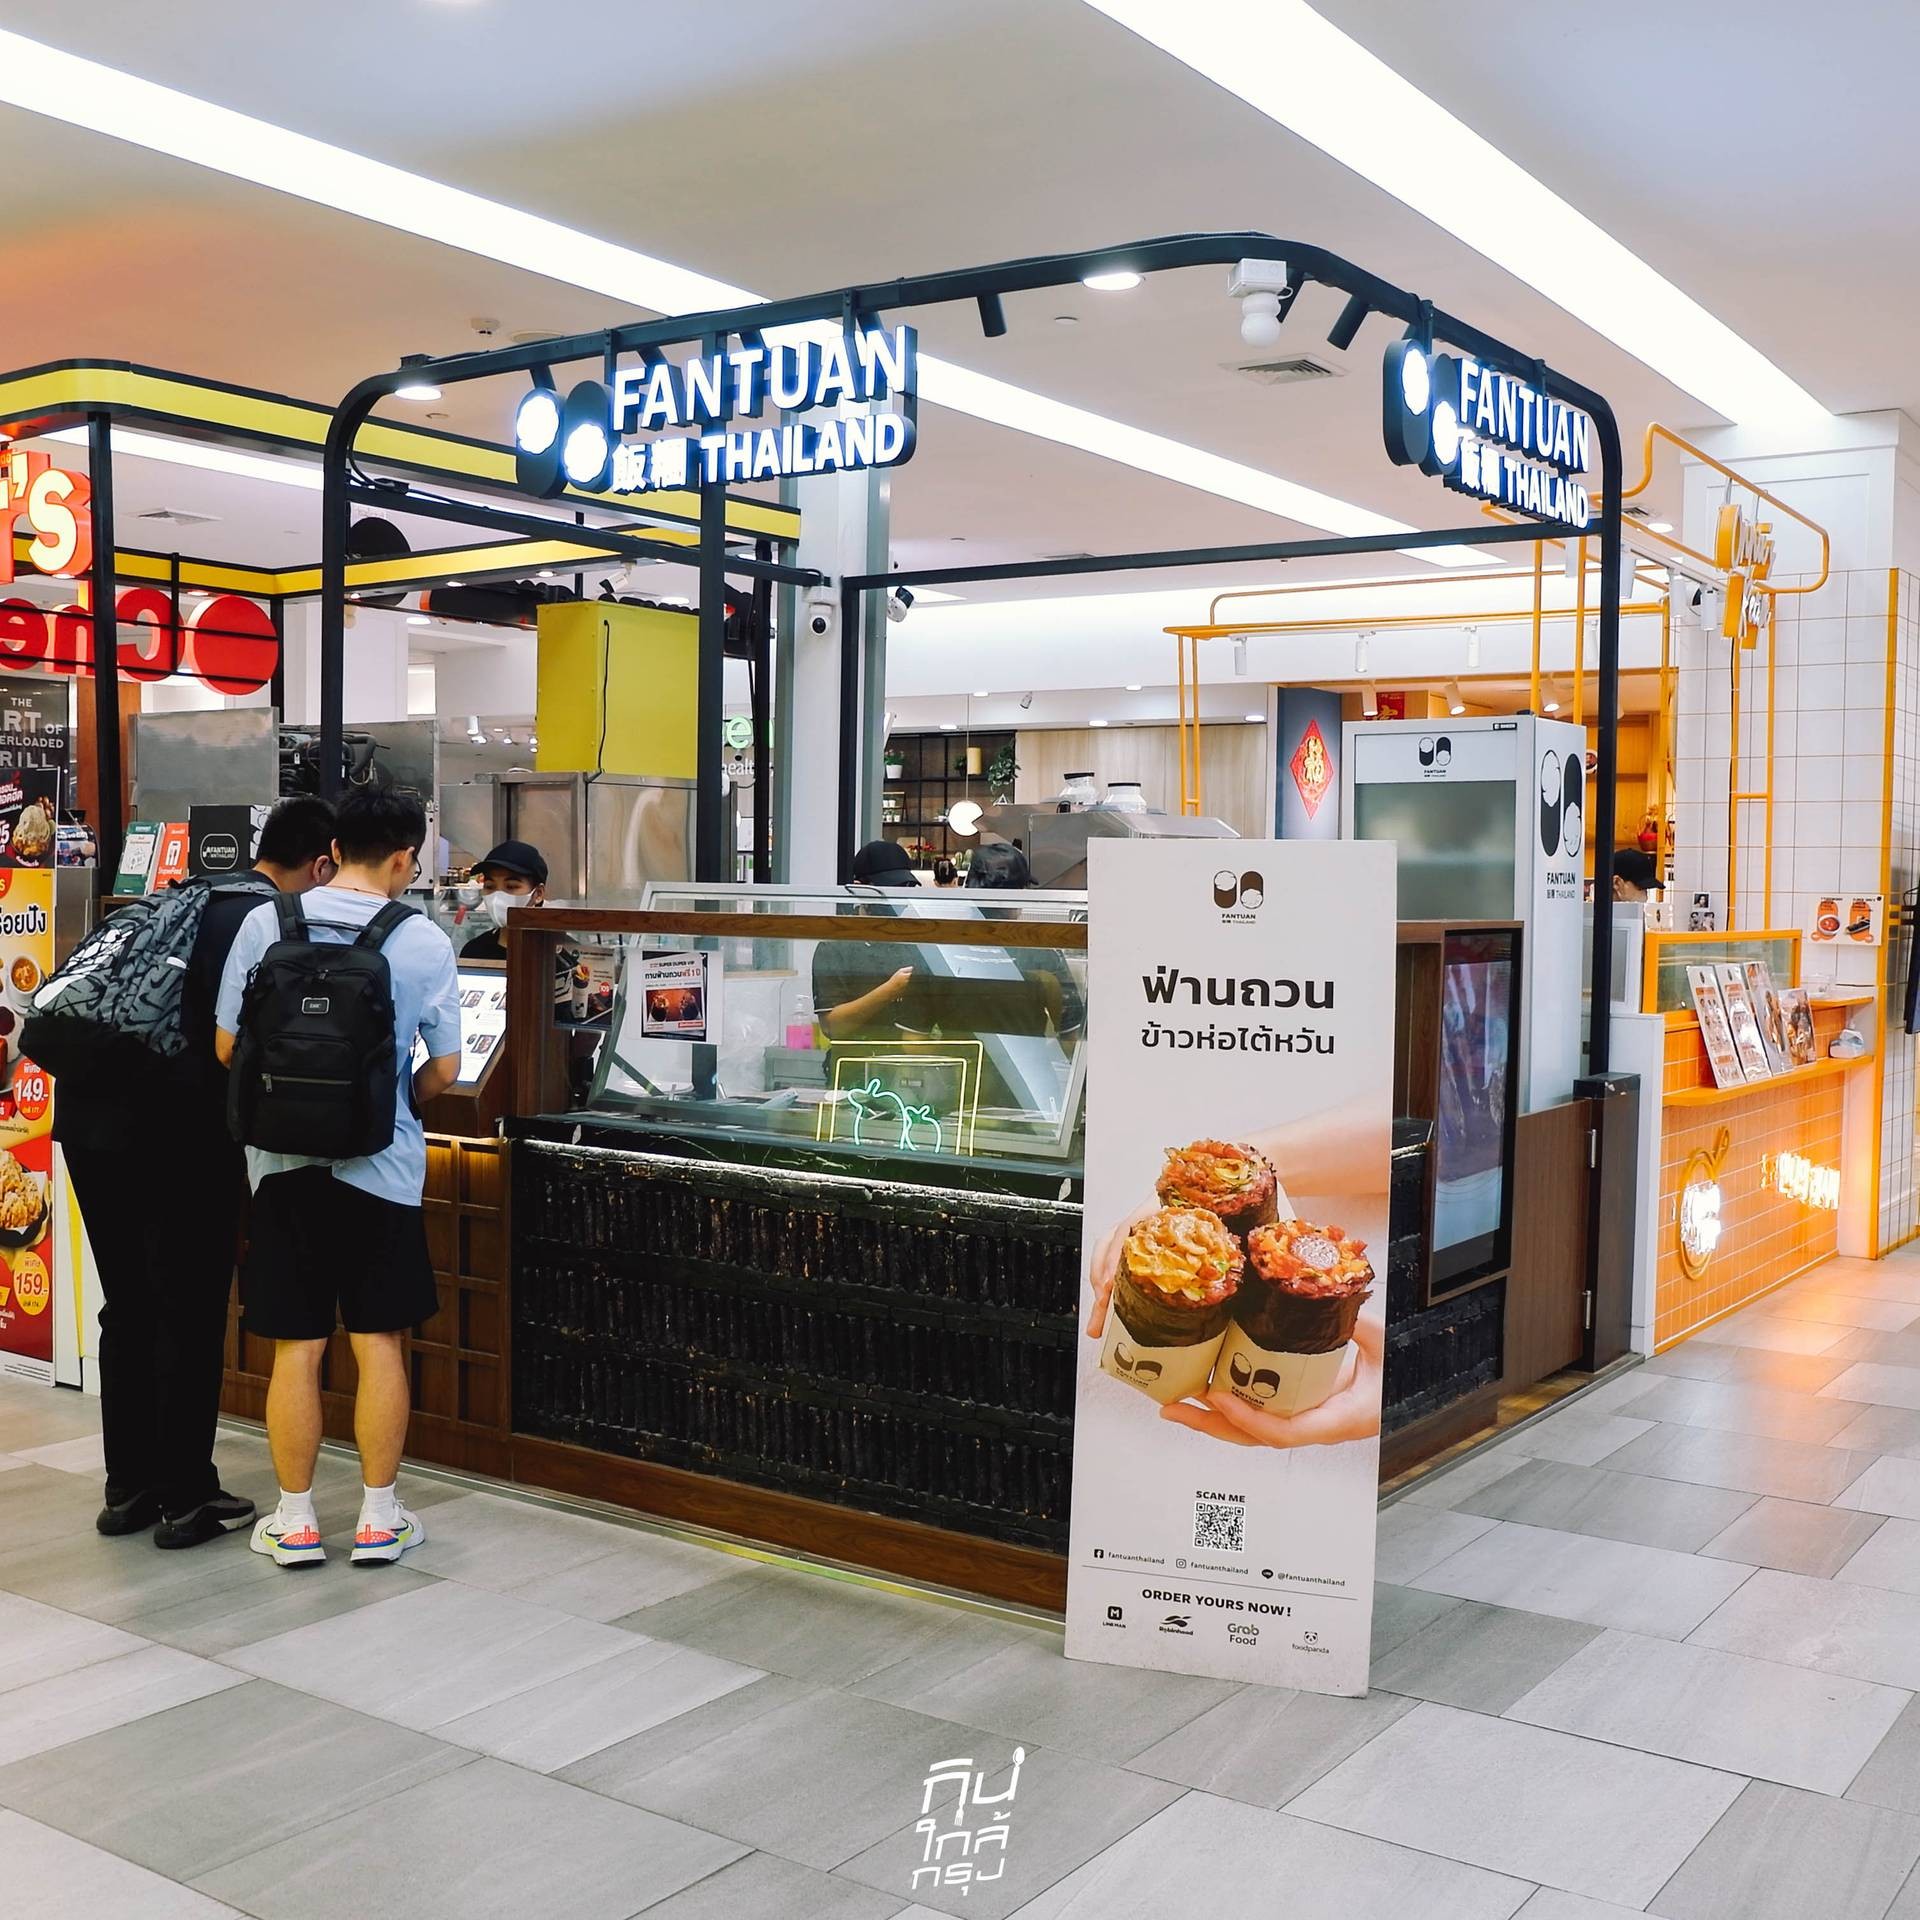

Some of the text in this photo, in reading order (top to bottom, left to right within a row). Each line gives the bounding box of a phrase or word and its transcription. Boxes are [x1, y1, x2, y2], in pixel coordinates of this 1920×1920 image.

[613, 325, 909, 432] FANTUAN
[1461, 358, 1589, 474] FANTUAN
[700, 413, 908, 485] THAILAND
[1503, 456, 1589, 530] THAILAND
[11, 697, 33, 707] THE
[0, 709, 64, 735] RT OF
[1546, 872, 1576, 885] FANTUAN
[1141, 964, 1335, 1010] ฟ่านถวน
[1141, 1020, 1336, 1055] ข้าวห่อไต้หวัน
[1196, 1490, 1246, 1503] SCAN ME
[1108, 1551, 1165, 1565] fantuanthailand
[1190, 1561, 1249, 1575] fantuanthailand
[1277, 1572, 1346, 1587] @fantuanthailand
[1142, 1588, 1191, 1604] ORDER
[1195, 1594, 1244, 1611] YOURS
[1227, 1623, 1260, 1637] Grab
[1229, 1634, 1257, 1646] Food
[1292, 1643, 1330, 1655] foodpanda
